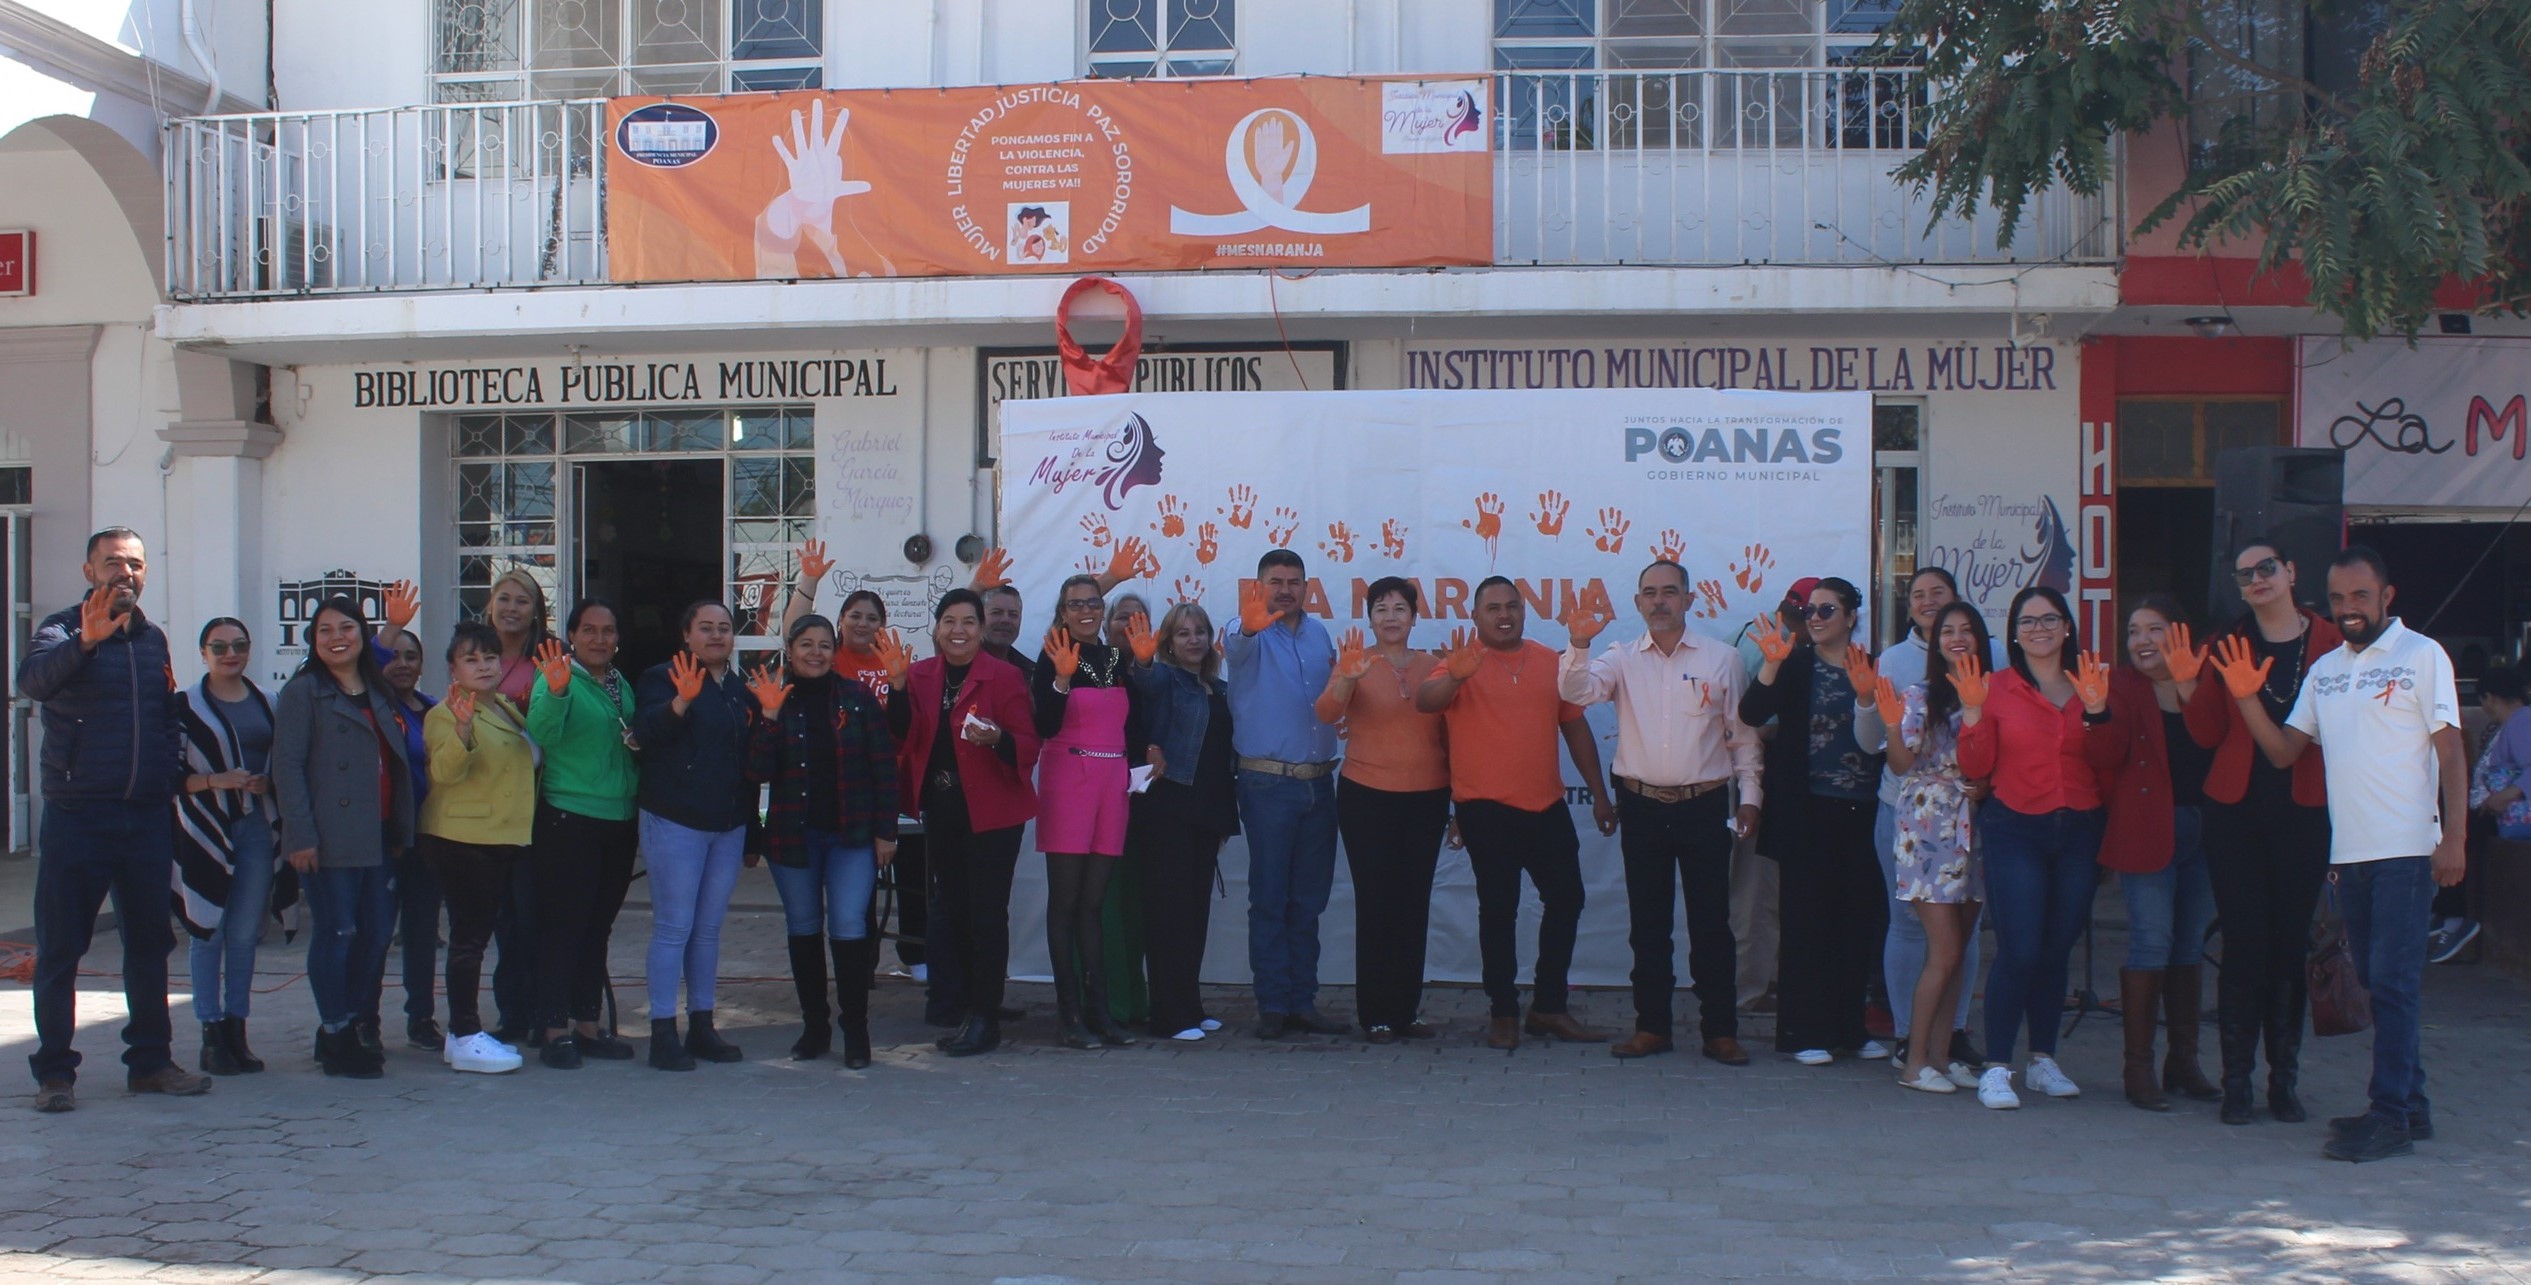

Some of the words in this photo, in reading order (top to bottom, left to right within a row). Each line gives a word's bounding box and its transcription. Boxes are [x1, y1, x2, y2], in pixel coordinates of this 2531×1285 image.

[995, 87, 1081, 119] JUSTICIA
[991, 134, 1060, 145] PONGAMOS
[1062, 133, 1082, 143] FIN
[1084, 132, 1094, 143] A
[1086, 104, 1122, 142] PAZ
[1384, 110, 1443, 135] Mujer
[947, 107, 995, 196] LIBERTAD
[999, 150, 1014, 160] LA
[1002, 179, 1056, 192] MUJERES
[1058, 177, 1081, 188] YA!!
[1005, 164, 1055, 175] CONTRA
[1057, 163, 1079, 173] LAS
[1082, 142, 1132, 255] SORORIDAD
[952, 204, 1001, 261] MUJER
[1216, 242, 1324, 257] #MESNARANJA
[354, 367, 545, 407] BIBLIOTECA
[560, 363, 702, 402] PUBLICA
[718, 358, 897, 398] MUNICIPAL
[1135, 356, 1262, 393] PUBLICOS
[1406, 349, 1595, 389] INSTITUTO
[1604, 347, 1801, 390] MUNICIPAL
[1810, 347, 1859, 390] DE
[1866, 347, 1915, 390] LA
[1926, 346, 2057, 390] MUJER
[1049, 430, 1080, 441] Instituto
[1082, 428, 1121, 443] Municipal
[1624, 416, 1666, 424] JUNTOS
[1670, 416, 1703, 424] HACIA
[1707, 416, 1721, 424] LA
[1725, 415, 1825, 425] TRANSFORMACIÓN
[1829, 417, 1844, 425] DE
[2330, 397, 2456, 454] La
[831, 429, 902, 462] Gabriel
[1071, 447, 1082, 458] De
[1085, 447, 1095, 458] La
[1624, 427, 1843, 464] POANAS
[1029, 455, 1096, 494] Mujer
[1647, 470, 1728, 481] GOBIERNO
[1735, 471, 1821, 482] MUNICIPAL
[1931, 494, 1977, 520] Instituto
[1977, 495, 2042, 526] Municipal
[1972, 528, 1987, 550] de
[1990, 528, 2007, 550] la
[1930, 545, 2023, 605] Mujer
